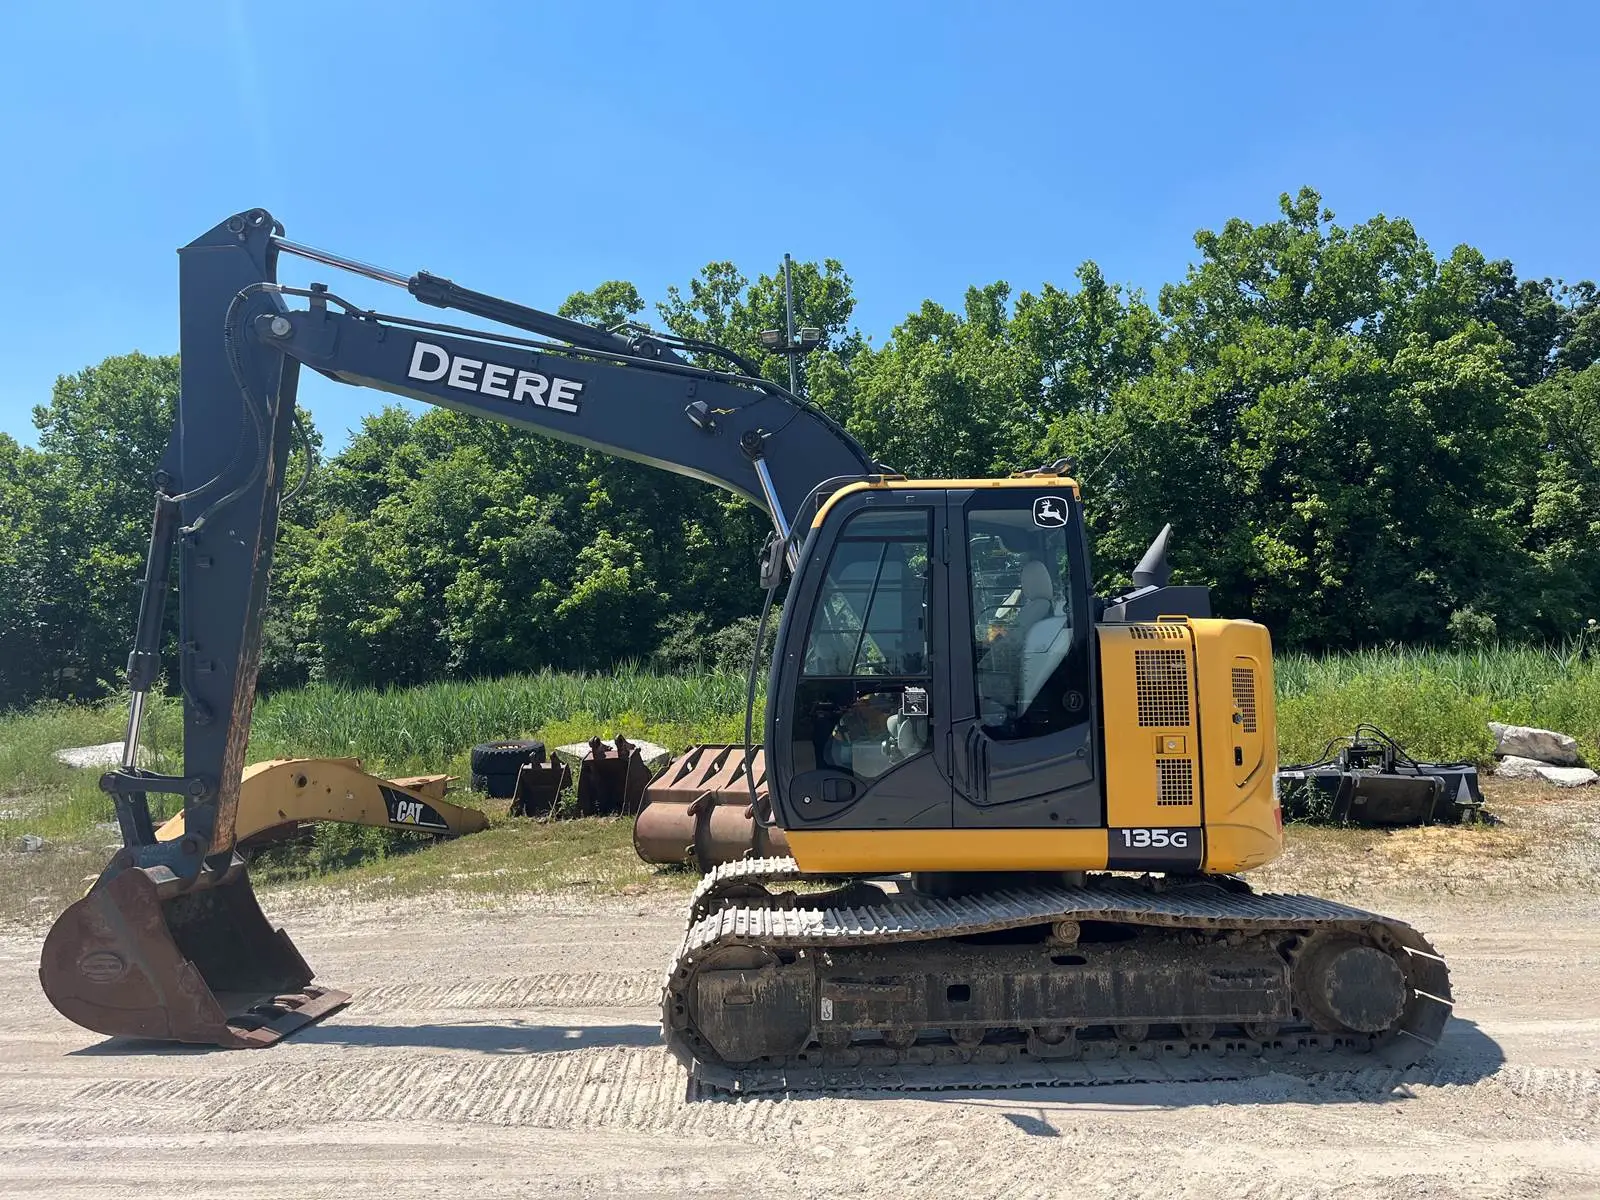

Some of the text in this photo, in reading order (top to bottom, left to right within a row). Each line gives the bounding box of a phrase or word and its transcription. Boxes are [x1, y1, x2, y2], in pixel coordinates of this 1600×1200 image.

[408, 341, 583, 413] DEERE
[396, 800, 424, 824] CAT
[1121, 829, 1188, 848] 135G
